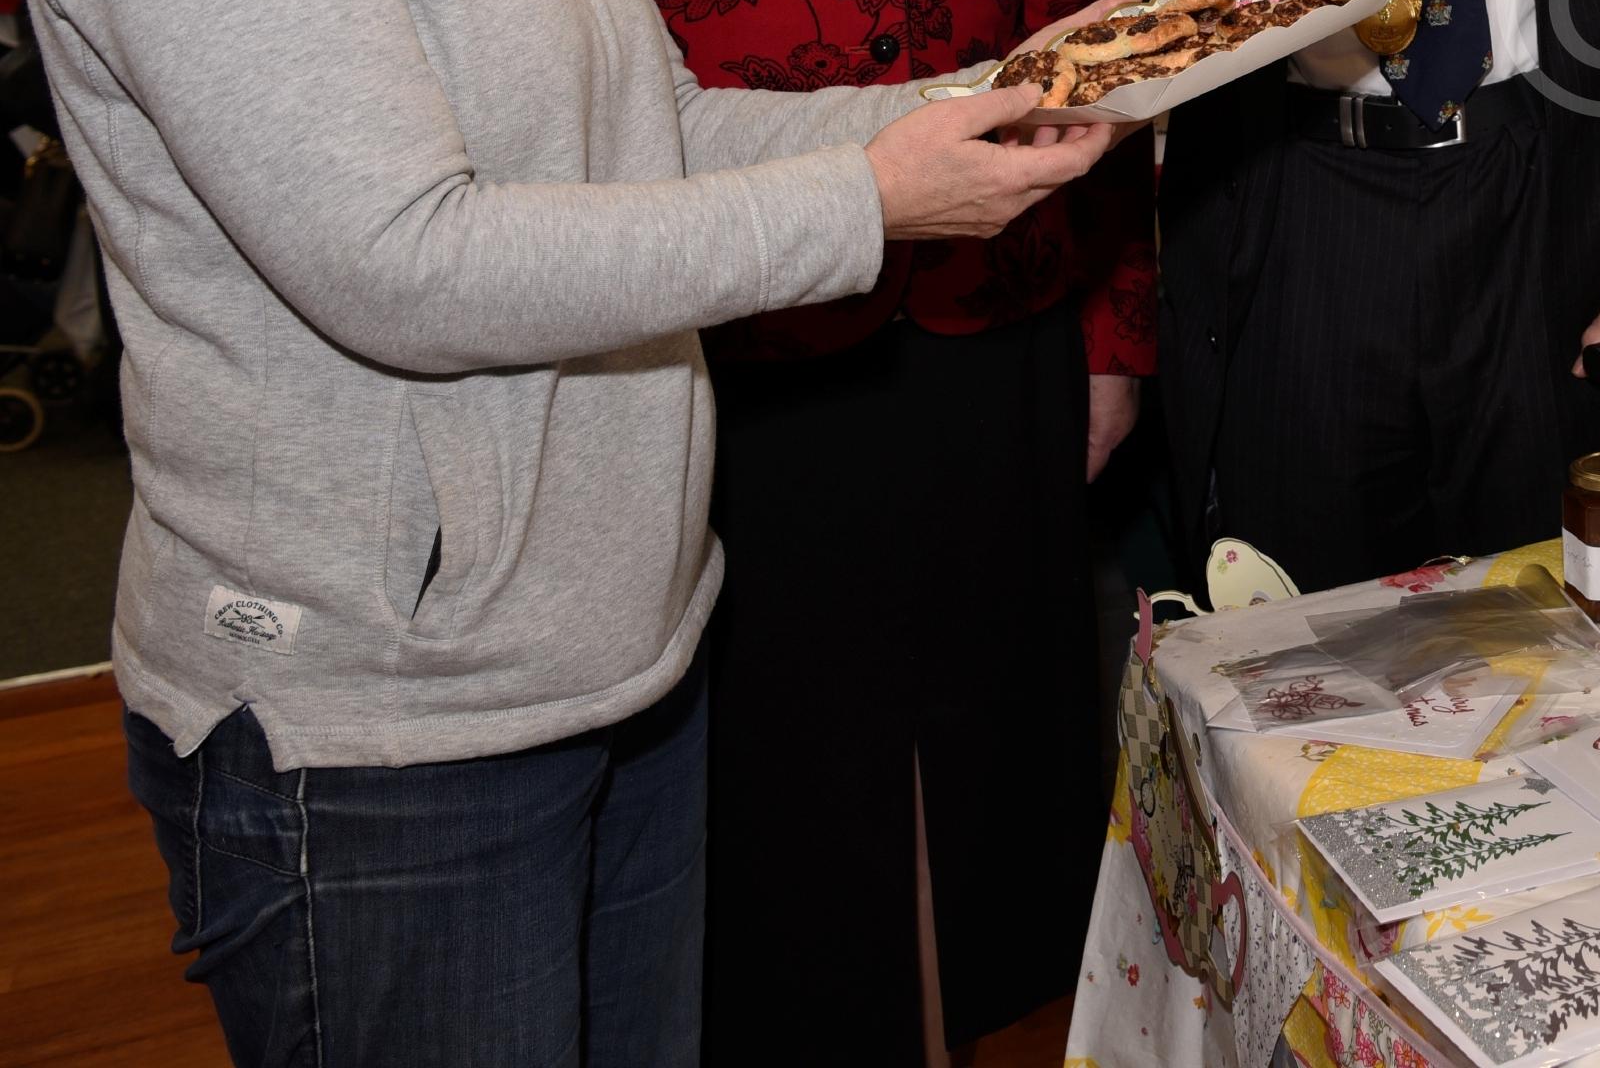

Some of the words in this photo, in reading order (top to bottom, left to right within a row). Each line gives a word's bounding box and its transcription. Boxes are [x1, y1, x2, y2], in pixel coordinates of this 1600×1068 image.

[214, 602, 235, 620] CREW
[235, 600, 279, 624] CLOTHING
[240, 614, 253, 624] 93
